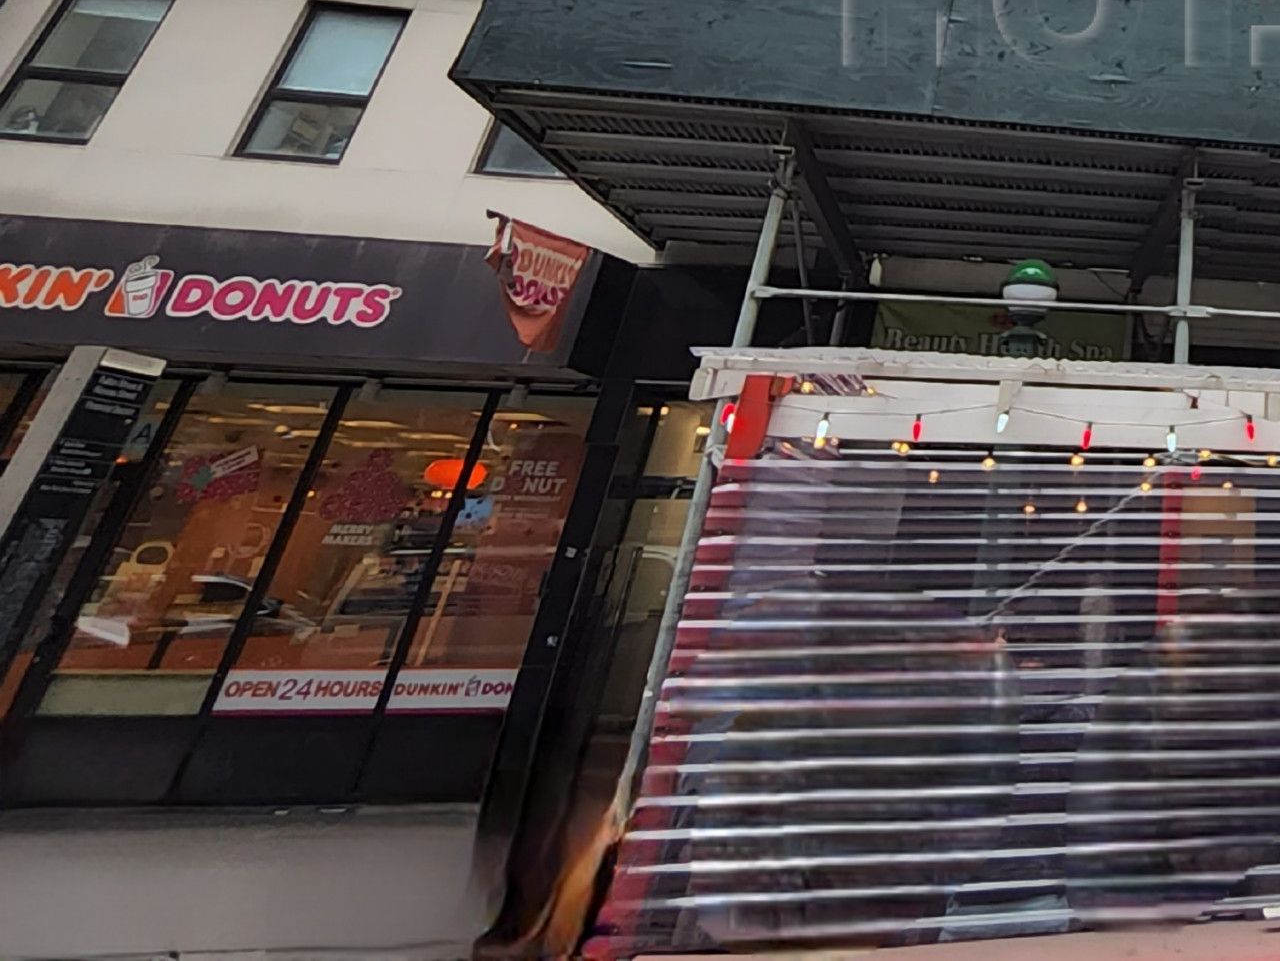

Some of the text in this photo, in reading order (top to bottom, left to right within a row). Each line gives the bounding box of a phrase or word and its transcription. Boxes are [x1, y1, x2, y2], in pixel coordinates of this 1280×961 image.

[169, 277, 393, 324] DONUTS
[508, 459, 559, 477] FREE
[224, 678, 383, 701] OPEN 24 HOURS
[393, 681, 465, 696] DUNKIN'
